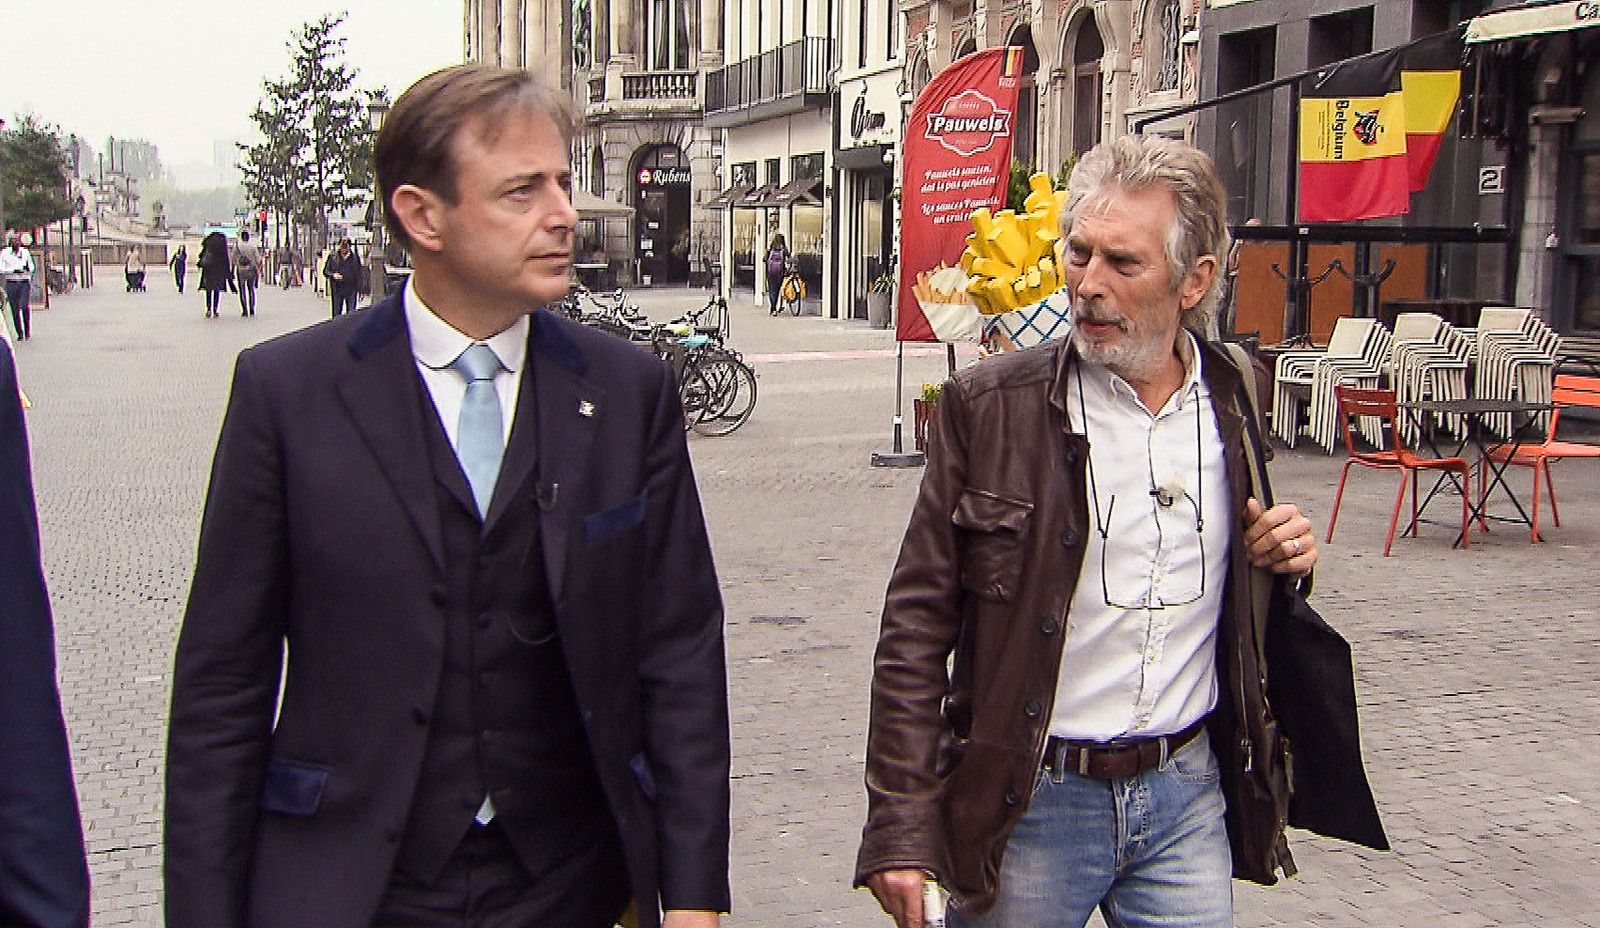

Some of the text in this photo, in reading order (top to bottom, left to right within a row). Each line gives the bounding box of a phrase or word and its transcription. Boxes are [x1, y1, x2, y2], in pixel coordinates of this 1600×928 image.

[933, 114, 1004, 133] Pauwels
[1332, 100, 1350, 159] Belgium
[653, 167, 691, 185] Rubens
[1481, 169, 1499, 190] 2
